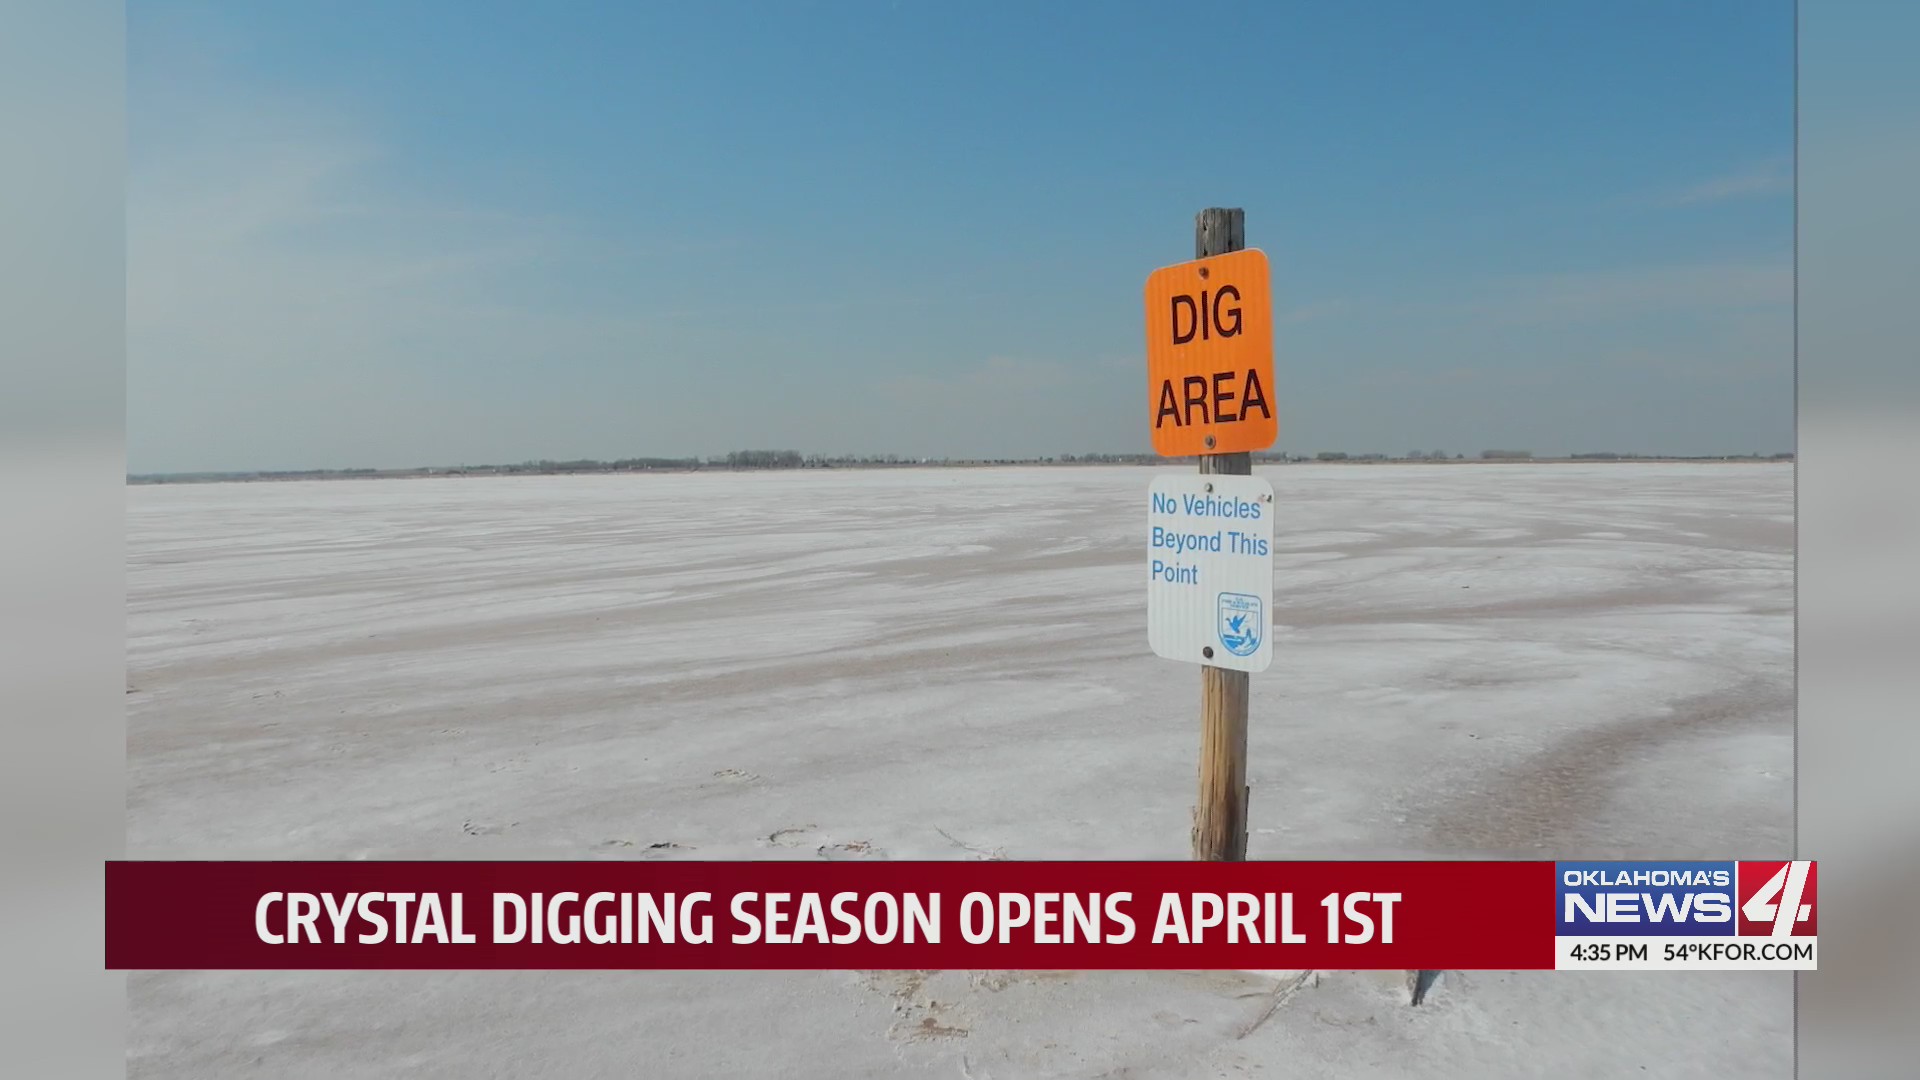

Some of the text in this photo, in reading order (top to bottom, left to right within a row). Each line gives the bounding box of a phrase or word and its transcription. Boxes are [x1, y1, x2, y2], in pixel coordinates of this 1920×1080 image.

[1171, 284, 1242, 345] DIG
[1155, 368, 1271, 428] AREA
[1153, 492, 1261, 519] No Vehicles
[1152, 526, 1268, 556] Beyond This
[1152, 560, 1198, 585] Point
